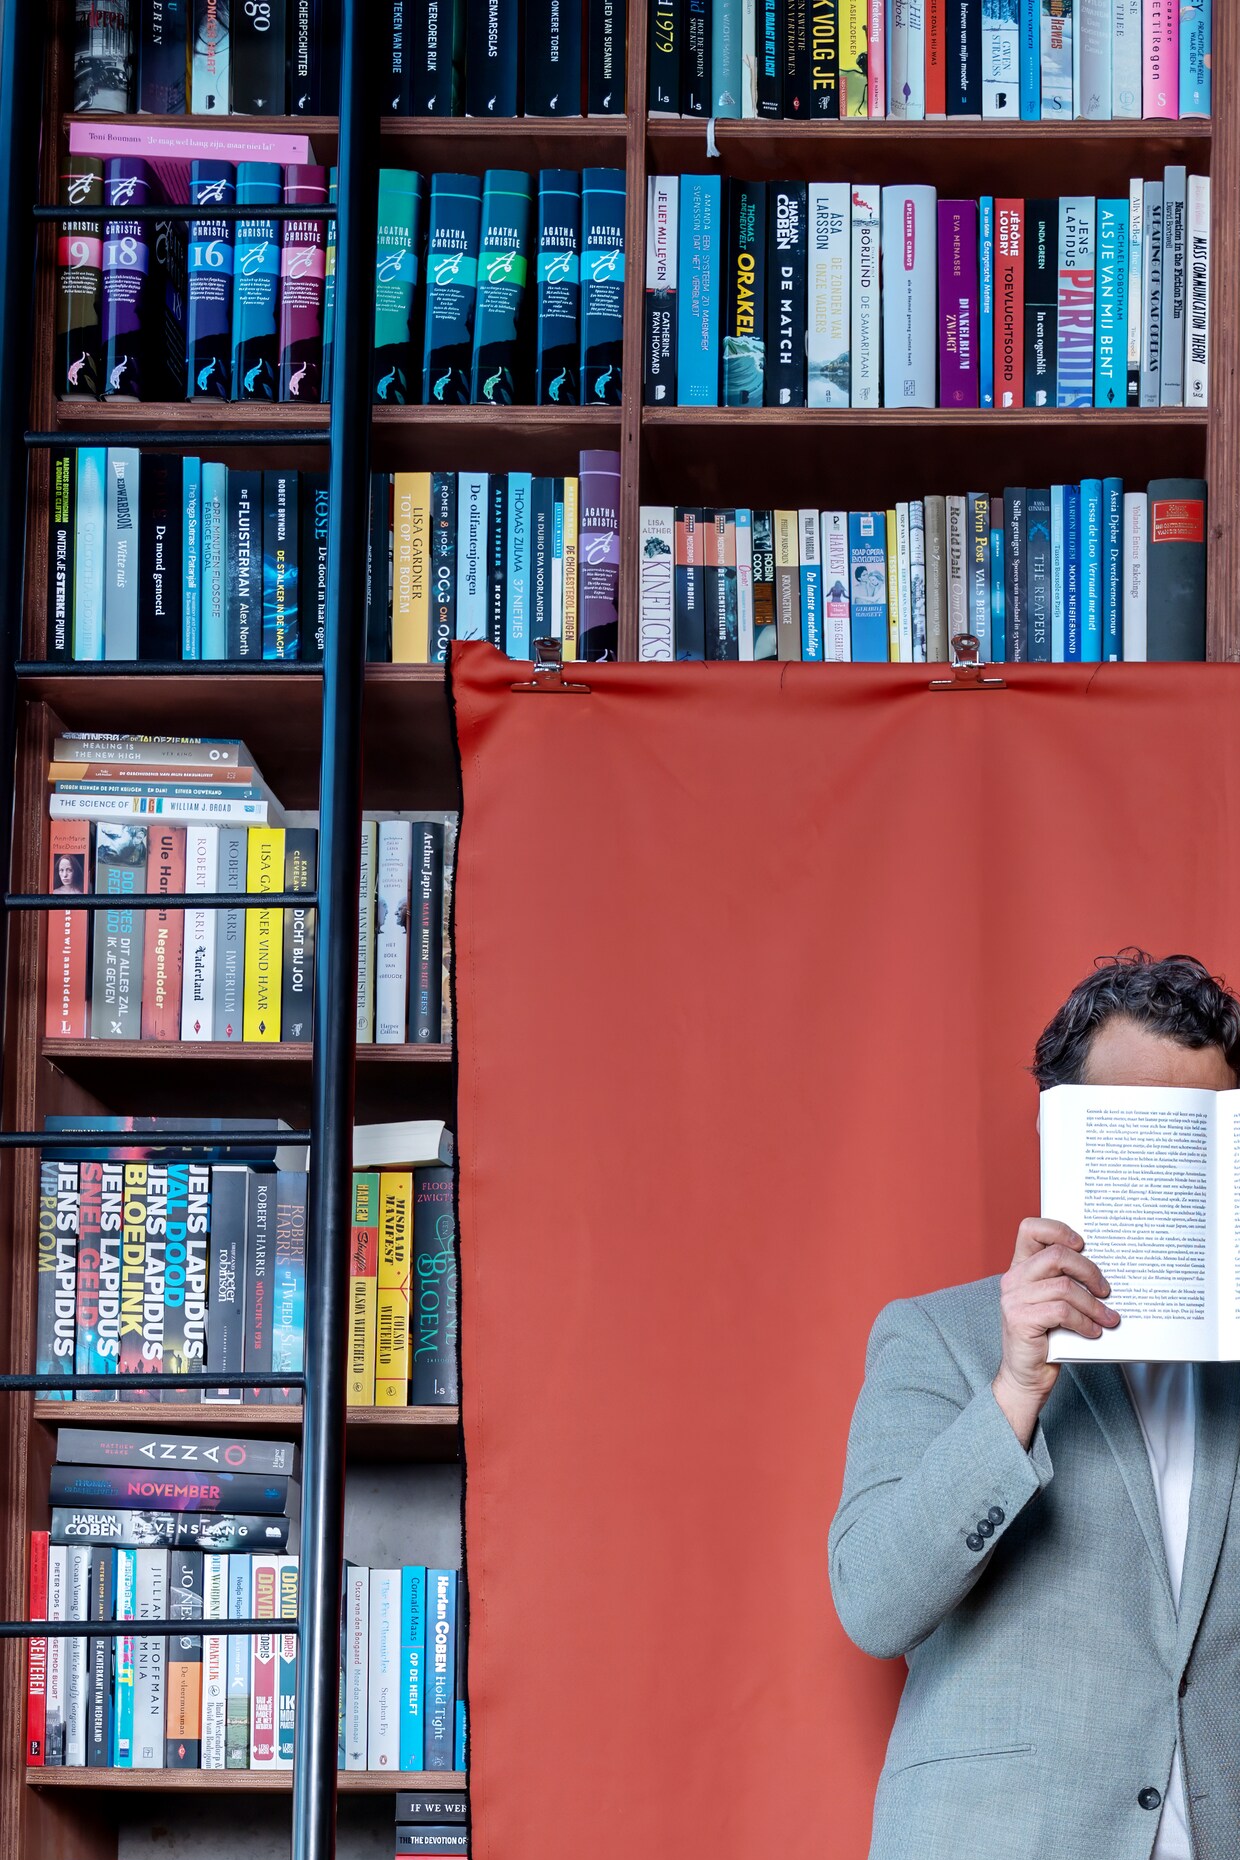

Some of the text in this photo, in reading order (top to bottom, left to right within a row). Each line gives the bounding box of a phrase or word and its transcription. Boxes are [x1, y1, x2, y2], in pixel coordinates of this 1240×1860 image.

[427, 1, 438, 71] VERLOREN RIJK
[70, 242, 89, 269] 9
[107, 236, 139, 266] 18
[195, 239, 224, 267] 16
[776, 194, 790, 250] COBEN
[830, 213, 844, 234] ÅSA
[736, 253, 755, 337] ORAKEL
[1100, 210, 1114, 379] ALS JE VAN MIJ BENT
[1192, 236, 1207, 364] MASS COMMUNICATION THEORY
[1035, 311, 1046, 375] In een ogenblik
[466, 484, 480, 595] De olifantenjongen
[975, 500, 988, 562] Elvin Post
[238, 501, 250, 655] FLUISTERMAN Alex North
[420, 832, 433, 899] Arthur Japin
[224, 950, 236, 1012] IMPERIUM
[54, 1162, 79, 1357] JENS LAPIDUS
[76, 1162, 102, 1327] SNEL GELD
[97, 1163, 123, 1357] JENS LAPIDUS
[121, 1163, 147, 1337] BLOEDLINK
[142, 1165, 167, 1360] JENS LAPIDUS
[164, 1163, 189, 1307] VAL DOOD
[182, 1164, 209, 1359] JENS LAPIDUS
[353, 1318, 366, 1374] WHITEHEAD
[380, 1306, 393, 1365] WHITEHEAD
[127, 1482, 220, 1499] NOVEMBER
[64, 1523, 122, 1537] COBEN
[132, 1523, 249, 1536] LEVENSLANG
[150, 1642, 160, 1715] HOFFMAN
[432, 1621, 449, 1740] COBEN Hold Tight
